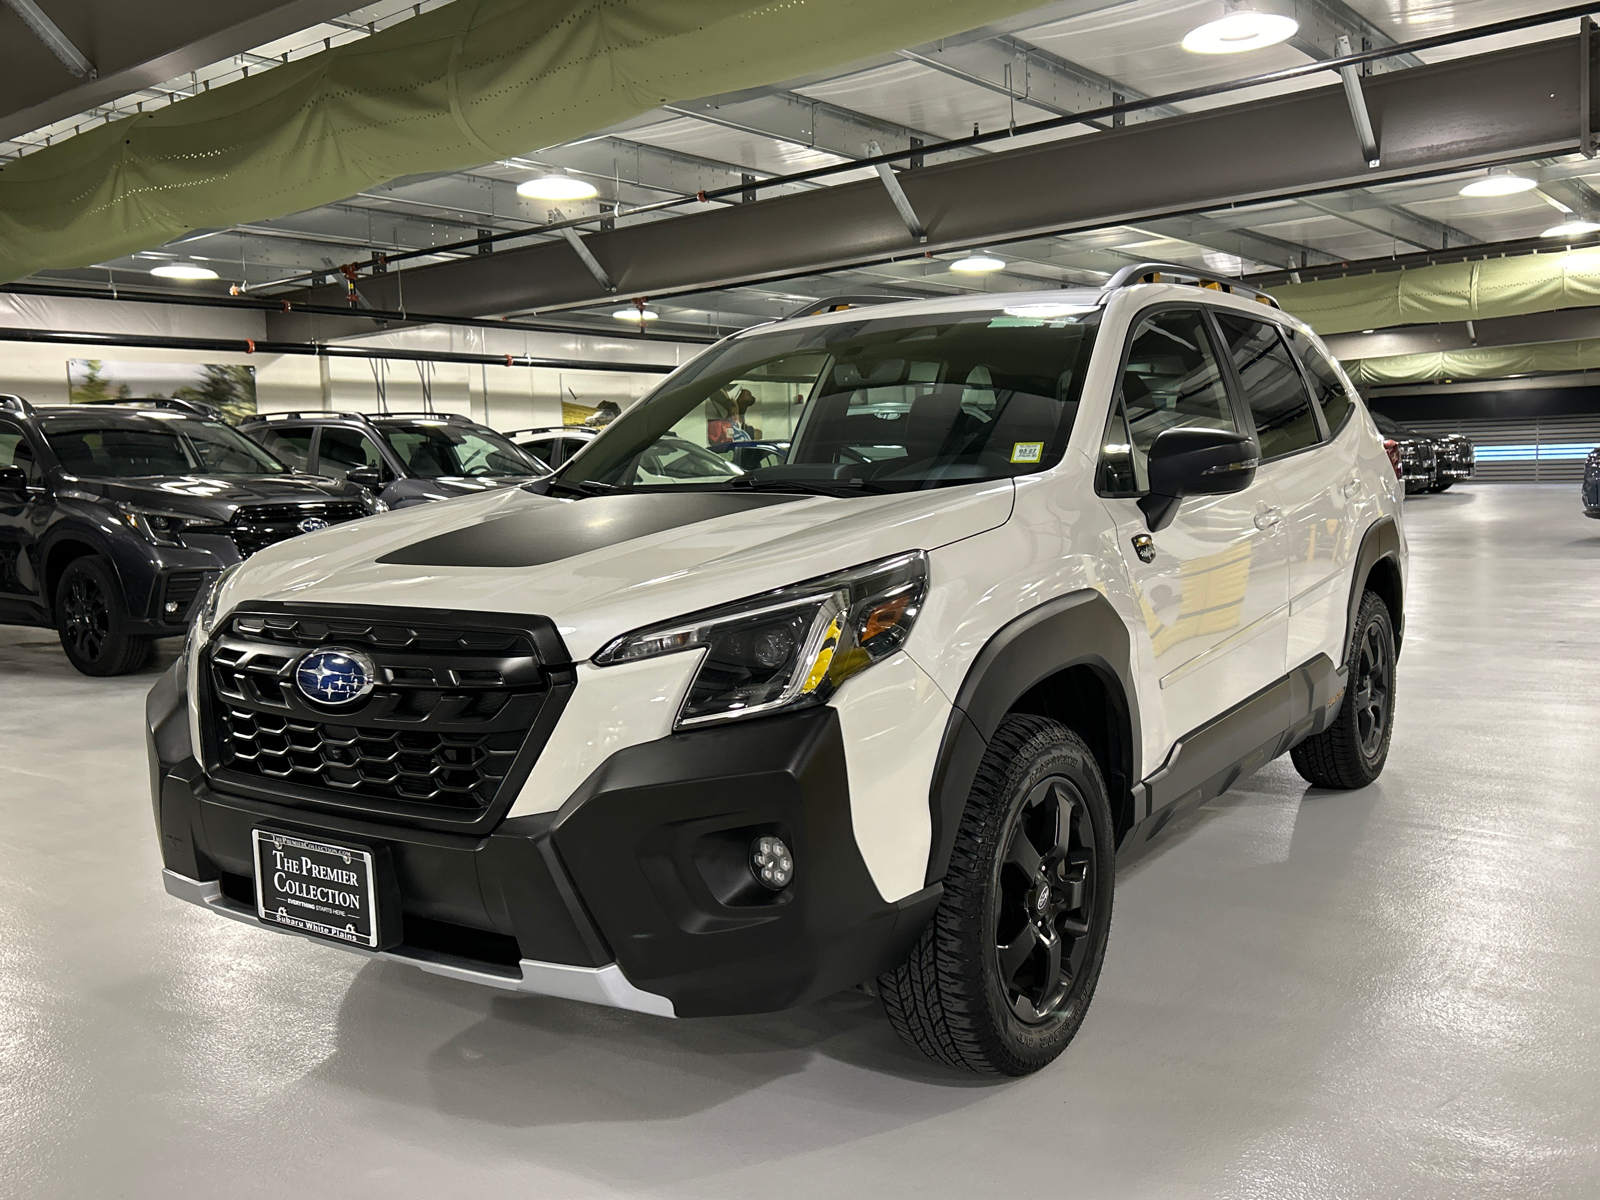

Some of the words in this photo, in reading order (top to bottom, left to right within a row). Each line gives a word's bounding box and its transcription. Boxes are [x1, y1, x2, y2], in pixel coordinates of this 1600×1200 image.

[272, 850, 300, 874] THE
[301, 856, 359, 887] PREMIER
[273, 871, 360, 910] COLLECTION
[287, 898, 316, 910] EVERYTHING
[315, 905, 333, 914] STARTS
[276, 914, 304, 928] Subaru
[305, 921, 329, 935] White
[331, 927, 357, 941] Plains
